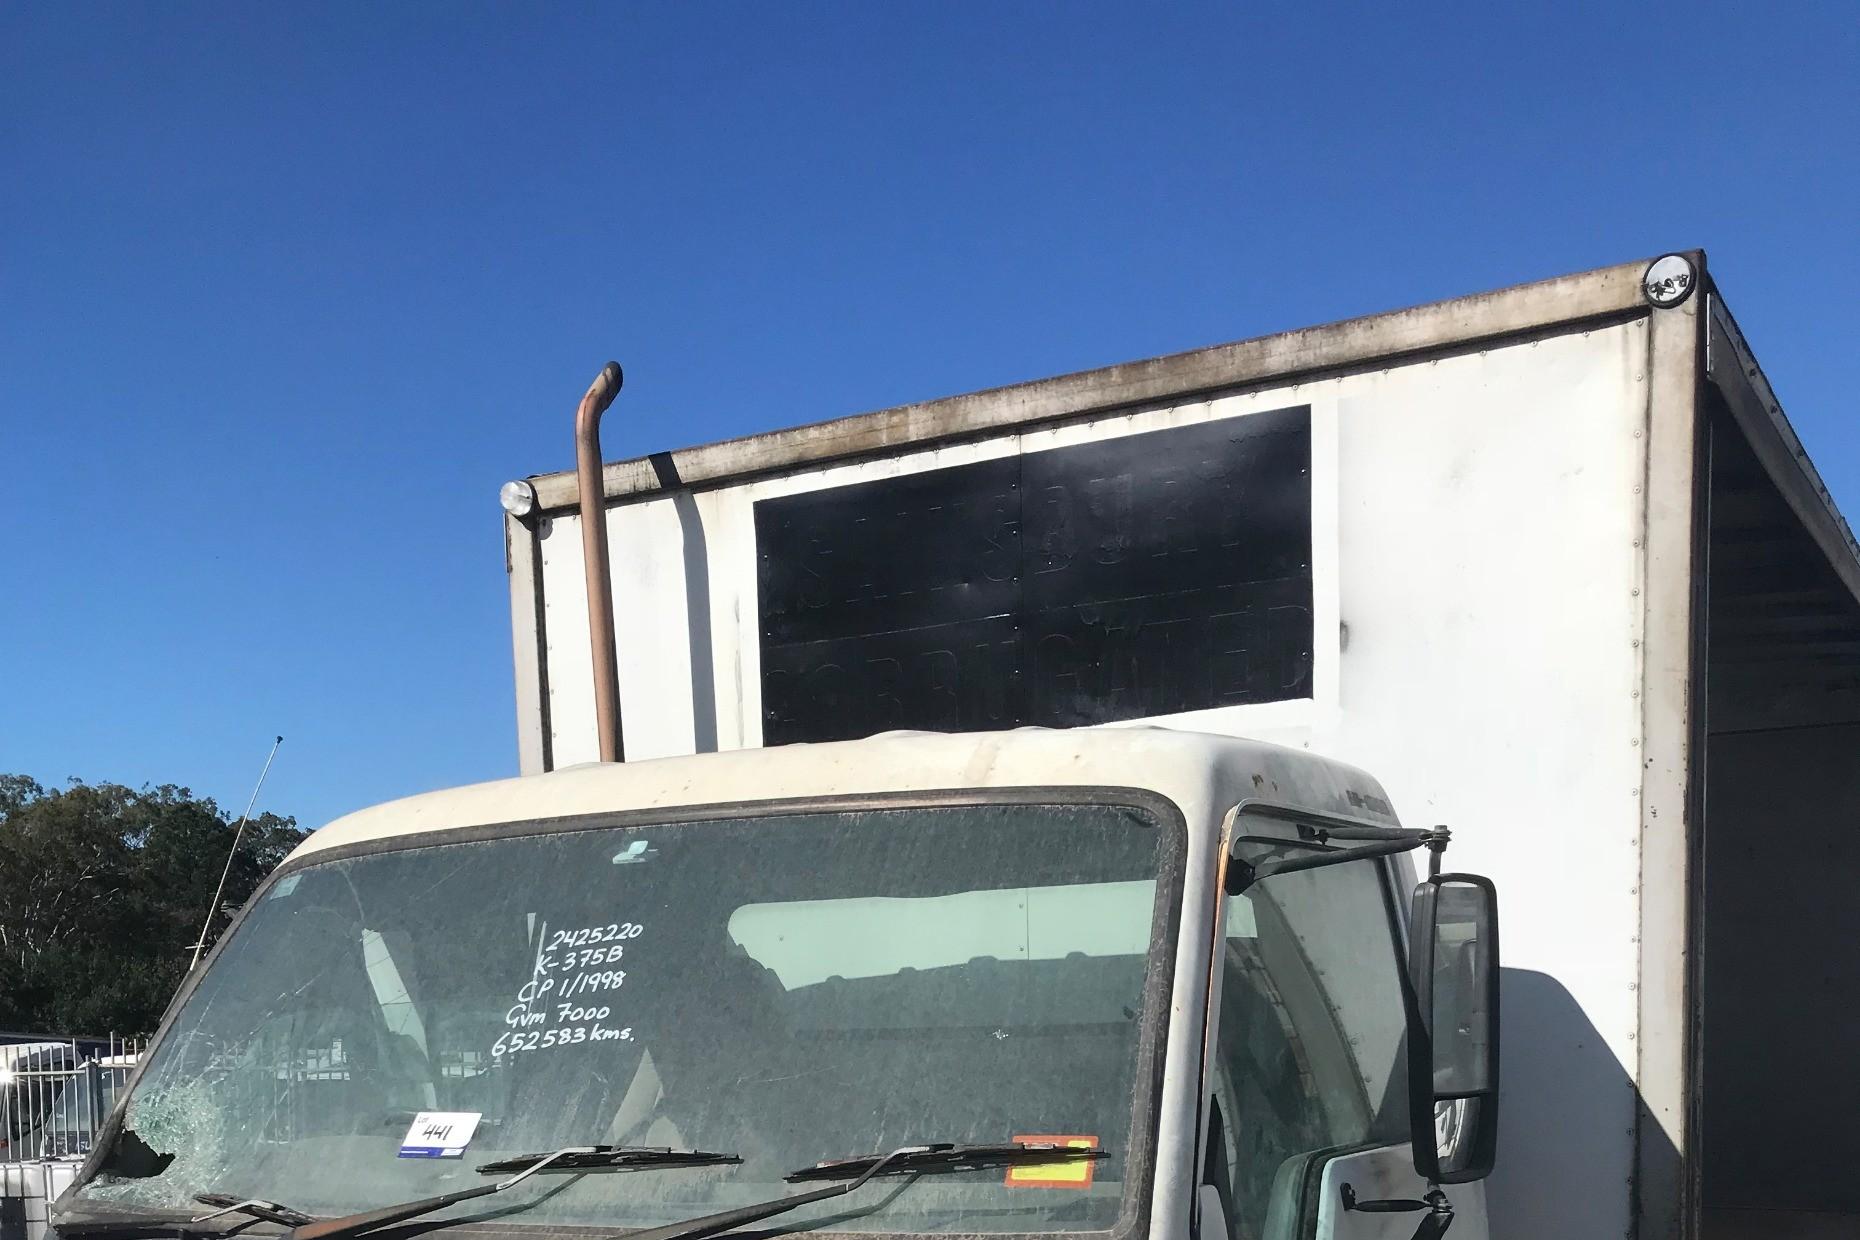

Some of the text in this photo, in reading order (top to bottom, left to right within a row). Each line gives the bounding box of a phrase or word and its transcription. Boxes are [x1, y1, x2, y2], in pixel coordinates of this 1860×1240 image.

[546, 922, 644, 952] 2425220
[518, 970, 627, 1002] CP 1/1998
[557, 1002, 611, 1023] 7000
[422, 1124, 453, 1140] 441
